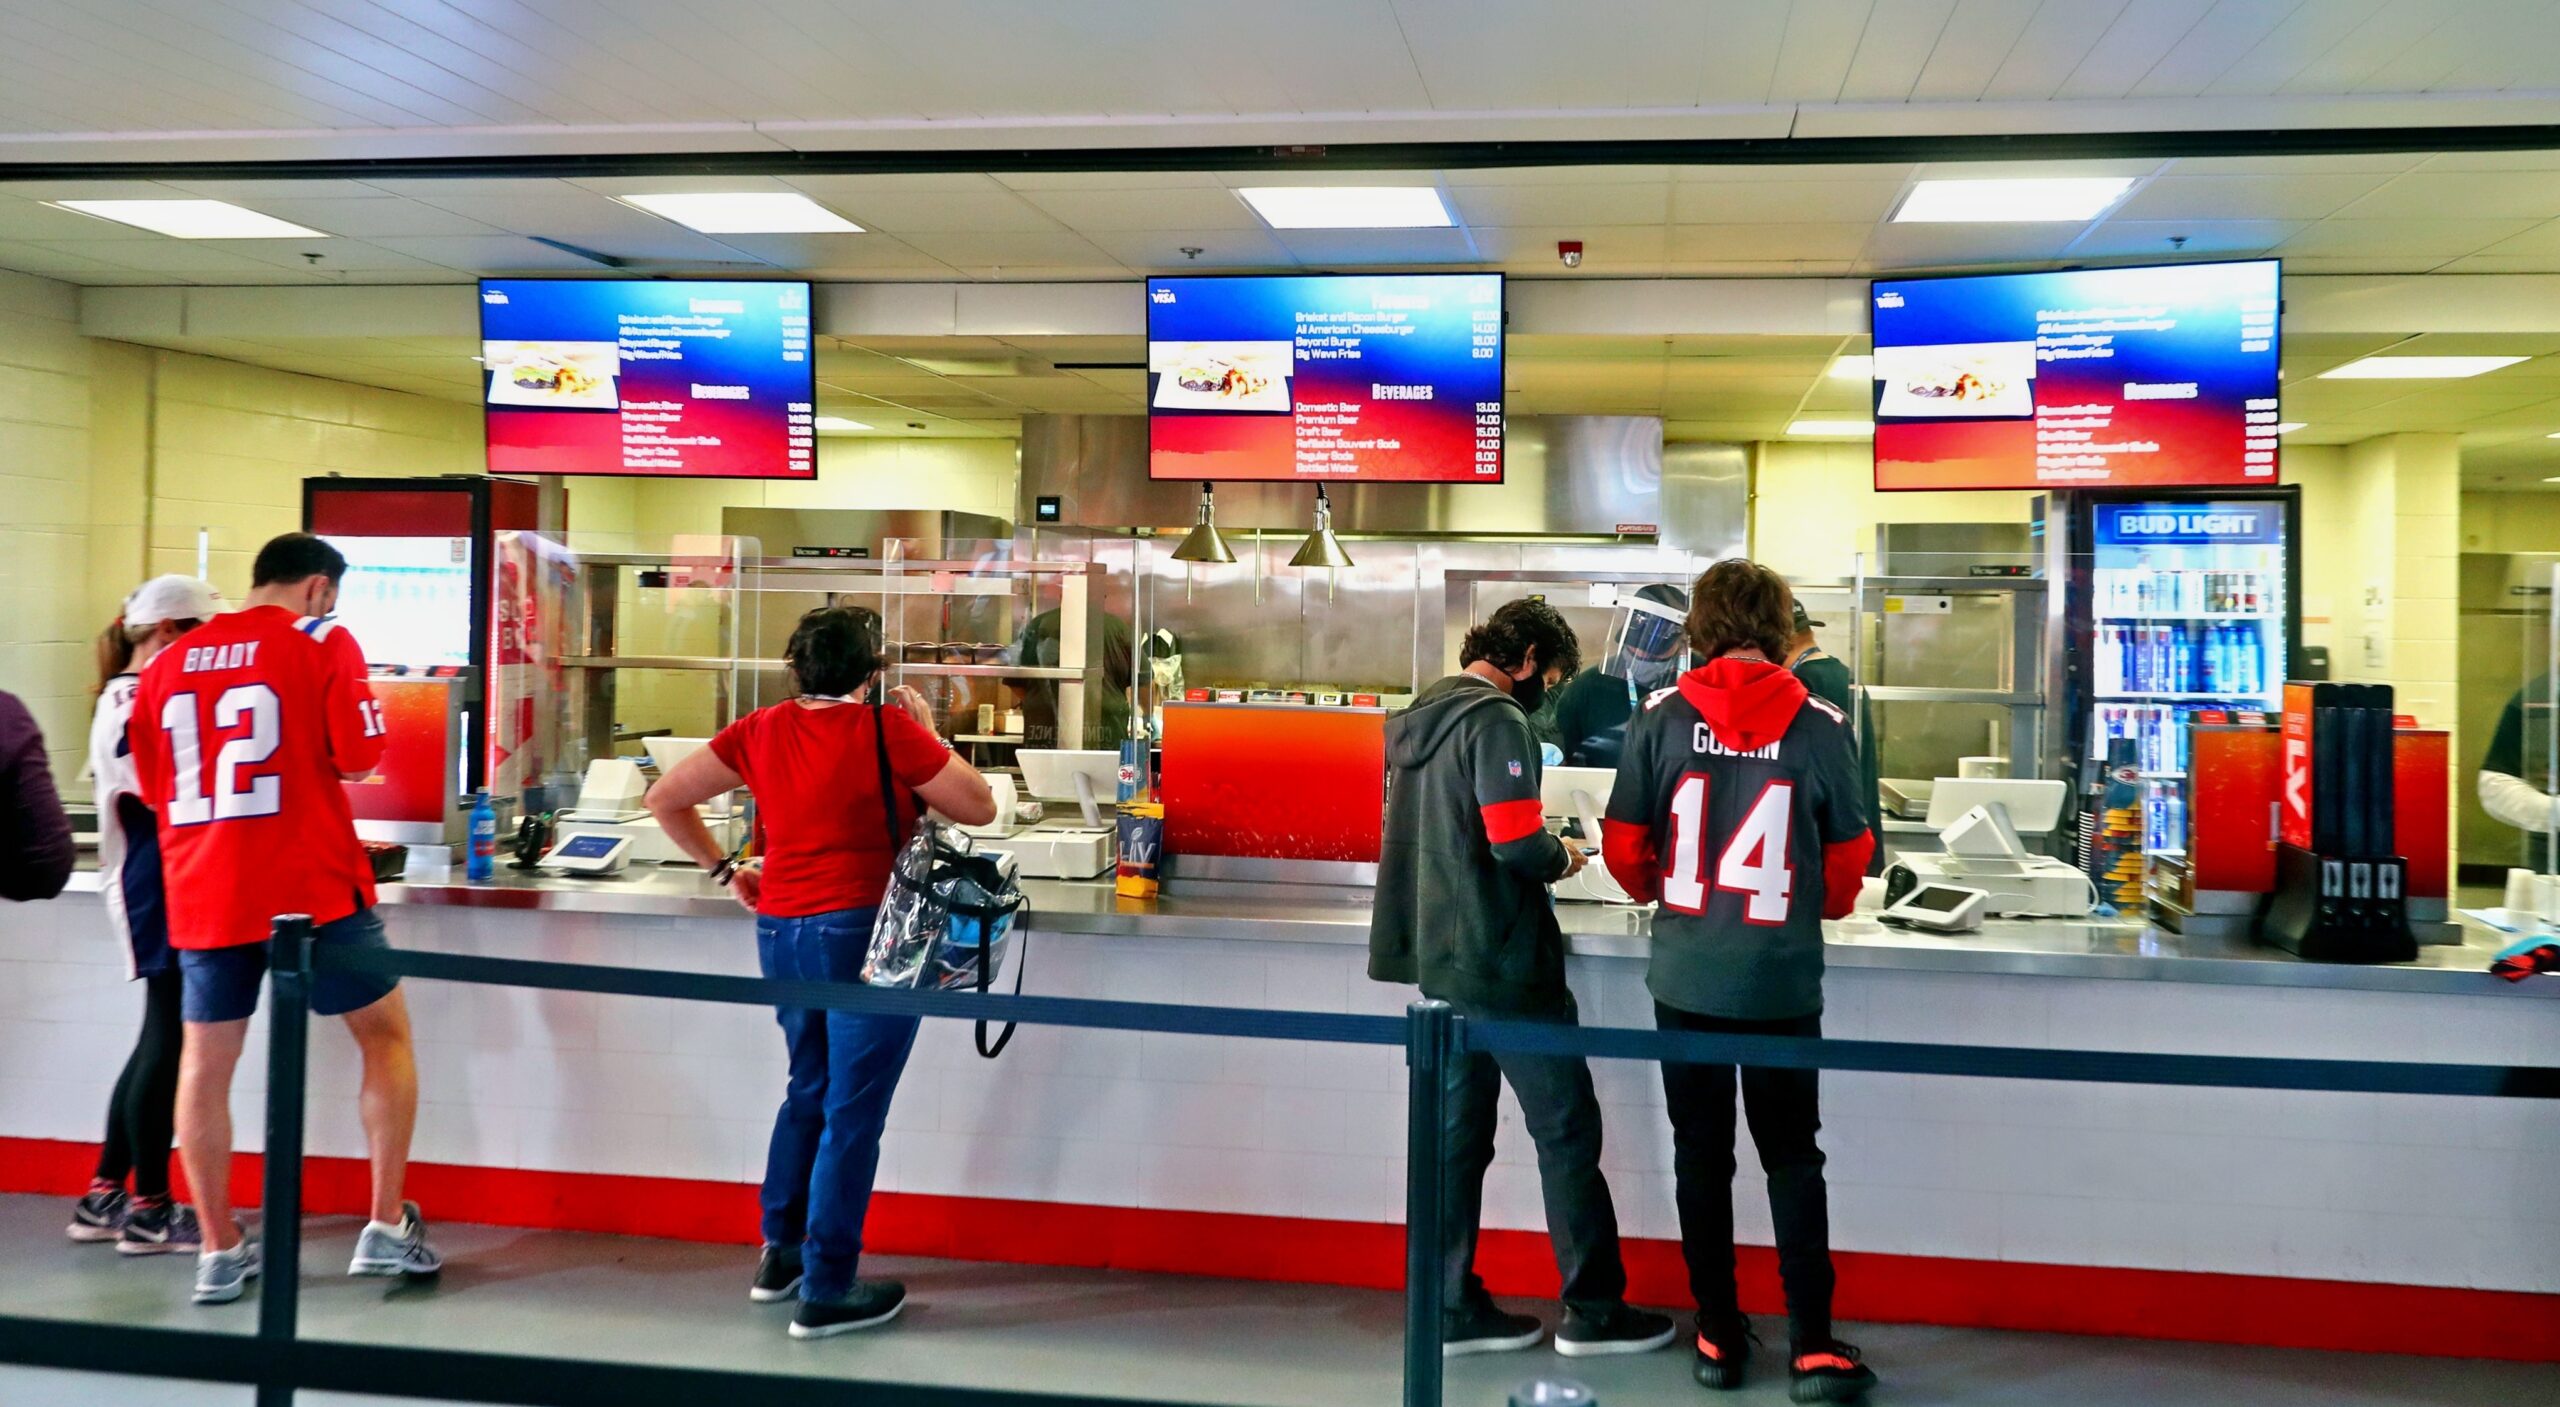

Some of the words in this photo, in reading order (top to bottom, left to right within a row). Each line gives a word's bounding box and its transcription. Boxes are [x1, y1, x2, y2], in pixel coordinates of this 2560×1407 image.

[1308, 324, 1350, 334] American
[1296, 336, 1329, 348] Beyond
[1330, 336, 1361, 348] Burger
[1296, 402, 1338, 412] Domestic
[1340, 402, 1361, 412] Beer
[1476, 402, 1500, 413] 13.00
[1296, 414, 1337, 425] Premium
[1337, 414, 1359, 425] Beer
[1476, 414, 1500, 425] 14.00
[1321, 427, 1343, 437] Beer
[1476, 427, 1500, 437] 15.00
[1476, 439, 1500, 450] 14.00
[2119, 515, 2177, 534] BUD
[2178, 515, 2257, 534] LIGHT
[182, 640, 260, 673] BRADY
[1692, 721, 1781, 761] GON
[161, 683, 281, 826] 12
[1661, 771, 1796, 927] 14
